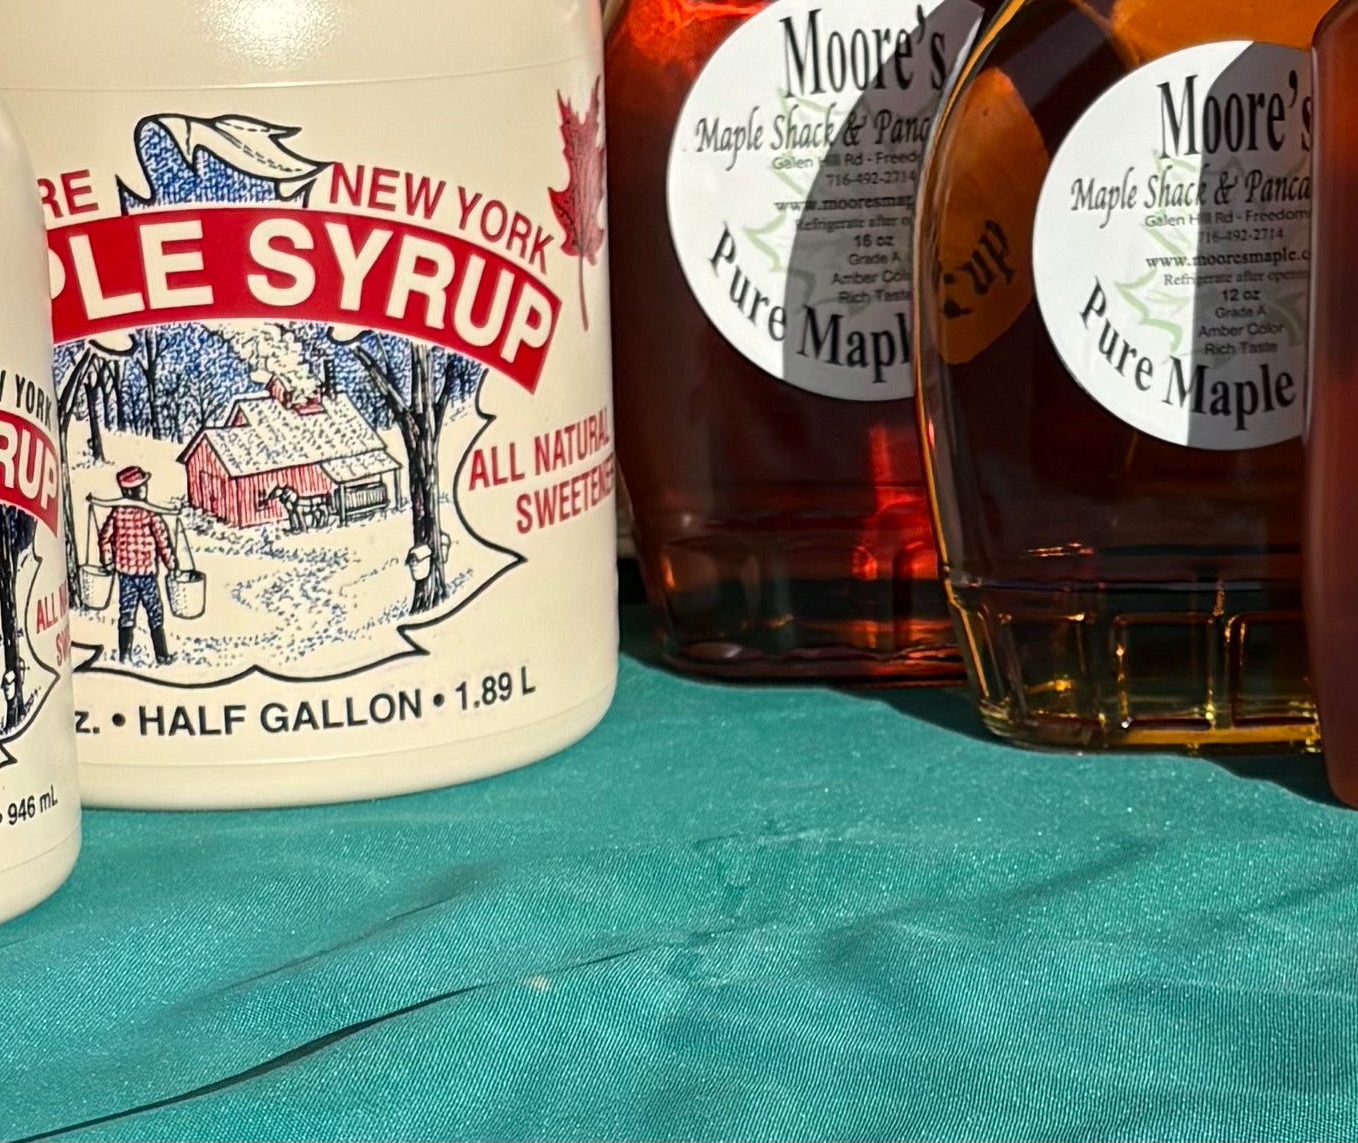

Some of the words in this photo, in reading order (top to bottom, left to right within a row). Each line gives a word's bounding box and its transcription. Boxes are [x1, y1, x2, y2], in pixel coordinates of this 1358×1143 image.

[779, 4, 946, 99] Moore's
[695, 106, 764, 172] Maple
[770, 102, 838, 152] Shack
[842, 113, 871, 147] &
[1156, 69, 1312, 160] Moore's
[772, 156, 814, 170] Galen
[1071, 167, 1137, 229] Maple
[1144, 163, 1210, 210] Shack
[1214, 170, 1240, 206] &
[328, 163, 446, 219] NEW
[456, 186, 555, 277] YORK
[1145, 214, 1185, 228] Galen
[246, 217, 555, 365] SYRUP
[708, 220, 788, 342] Pure
[1222, 289, 1239, 302] 12
[1079, 276, 1154, 392] Pure
[1162, 355, 1296, 433] Maple
[1199, 324, 1243, 338] Amber
[1247, 322, 1283, 335] Color
[1204, 342, 1236, 356] Rich
[15, 373, 52, 432] YORK
[468, 441, 526, 492] ALL
[534, 407, 610, 476] NATURAL
[139, 703, 246, 736] HALF
[260, 688, 424, 734] GALLON
[455, 671, 515, 713] 1.89
[520, 666, 536, 697] L
[7, 799, 36, 826] 946
[39, 785, 59, 813] mL
